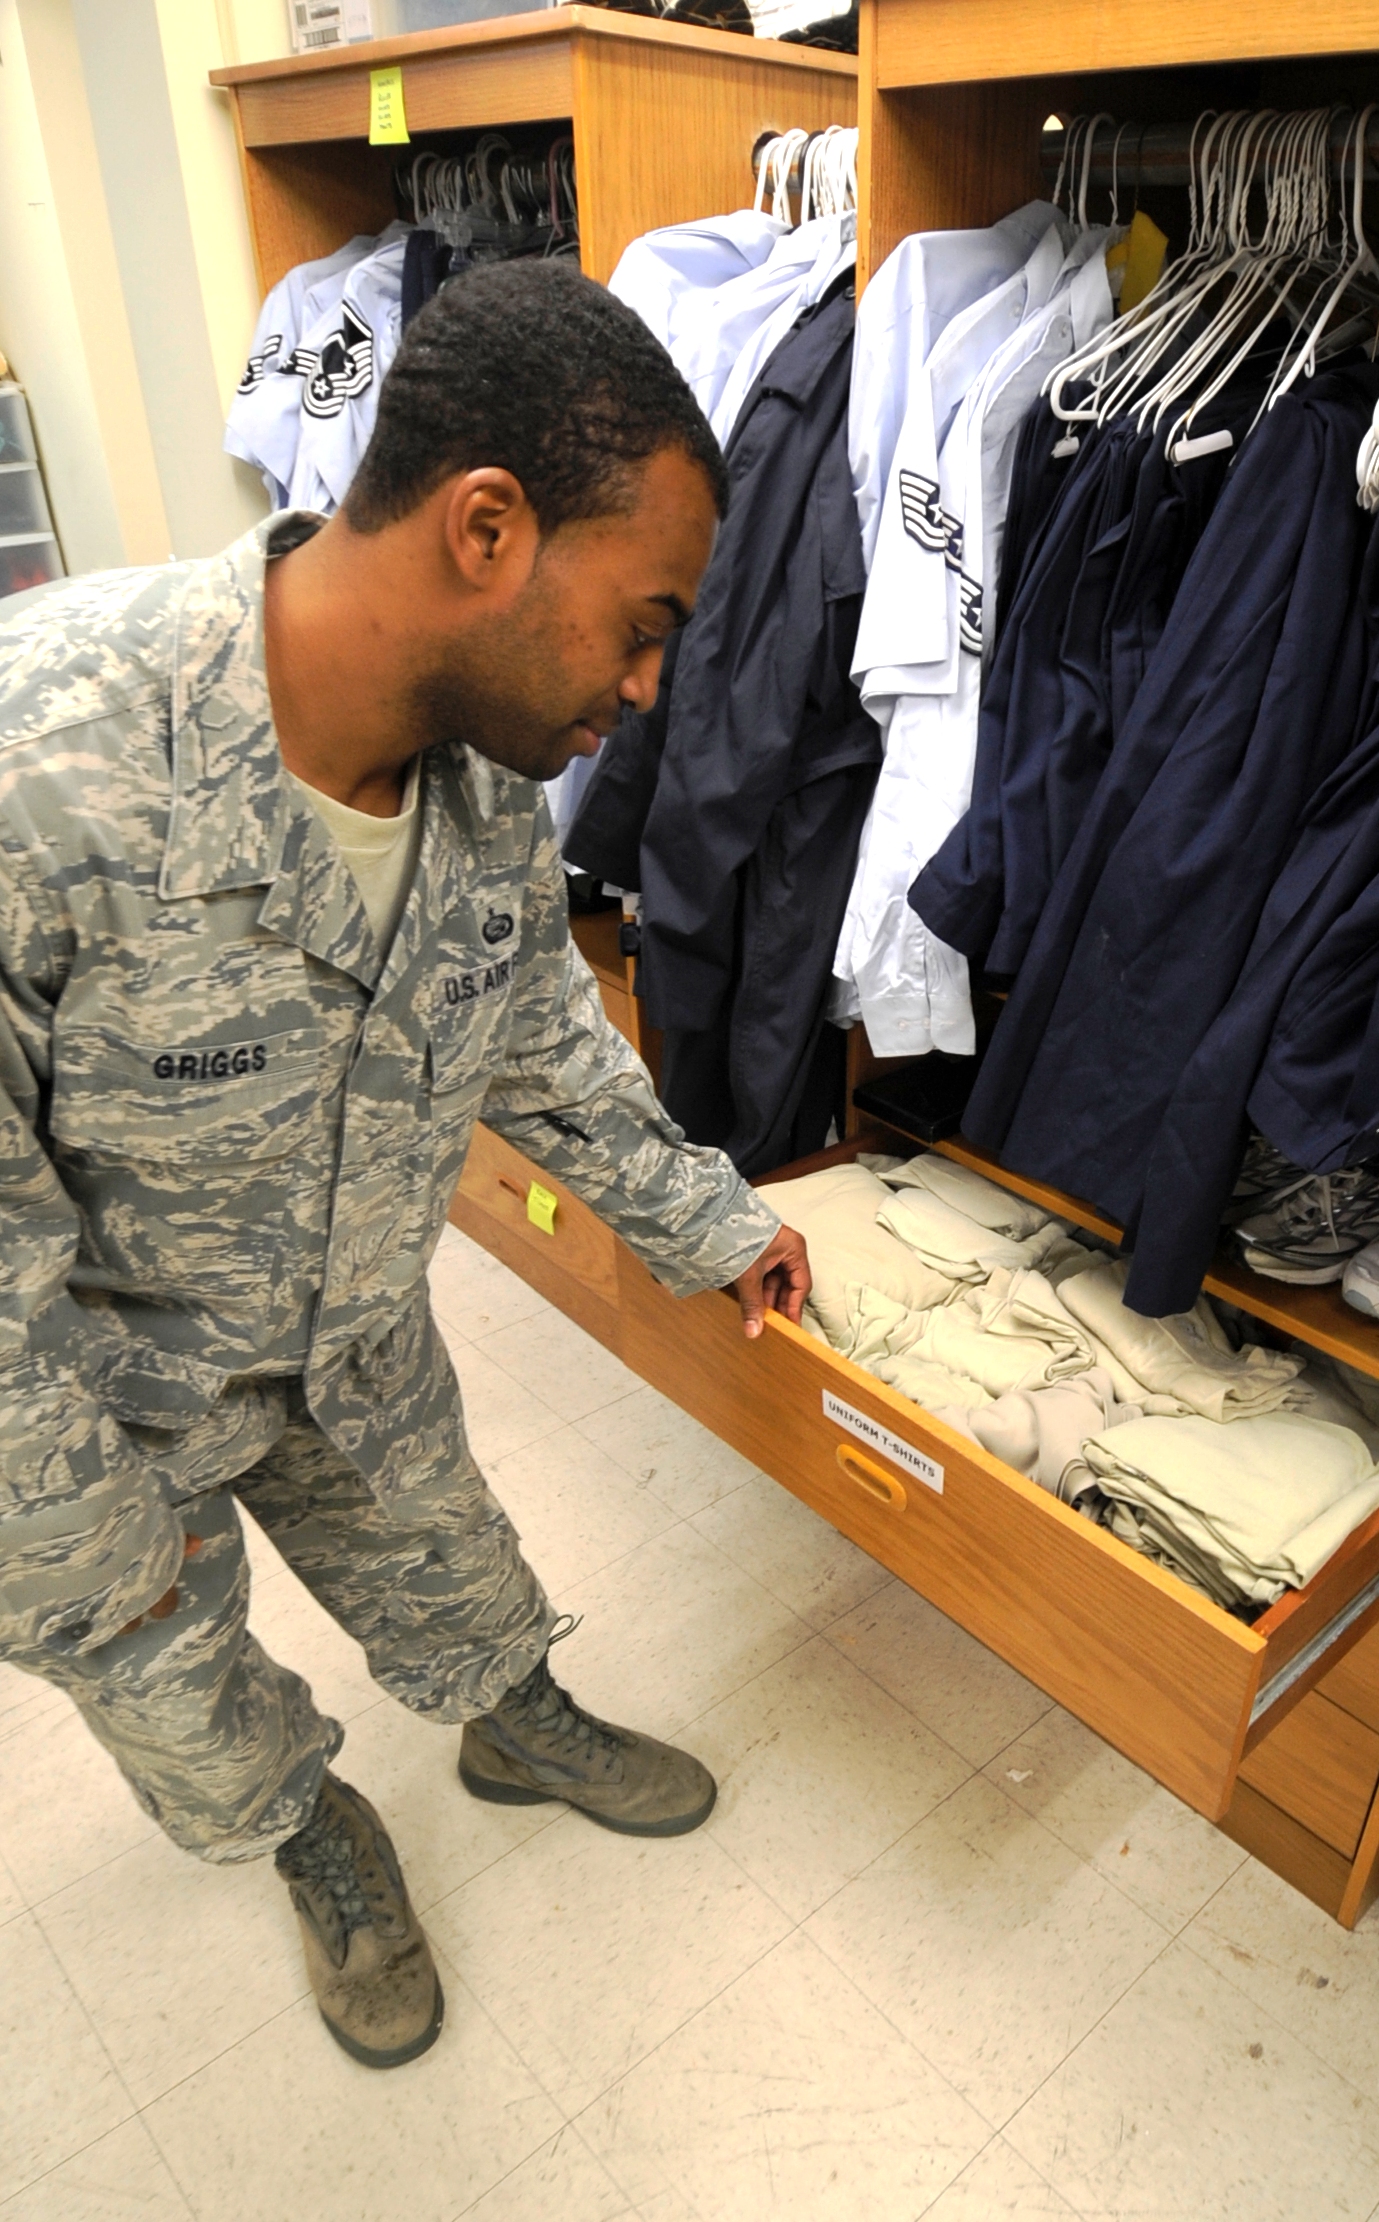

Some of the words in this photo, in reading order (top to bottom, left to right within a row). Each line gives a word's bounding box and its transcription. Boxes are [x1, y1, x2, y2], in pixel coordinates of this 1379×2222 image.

[445, 975, 479, 1005] U.S.
[484, 961, 509, 994] AIR
[154, 1044, 267, 1079] GRIGGS
[828, 1400, 879, 1440] UNIFORM
[881, 1435, 935, 1478] T-SHIRTS
